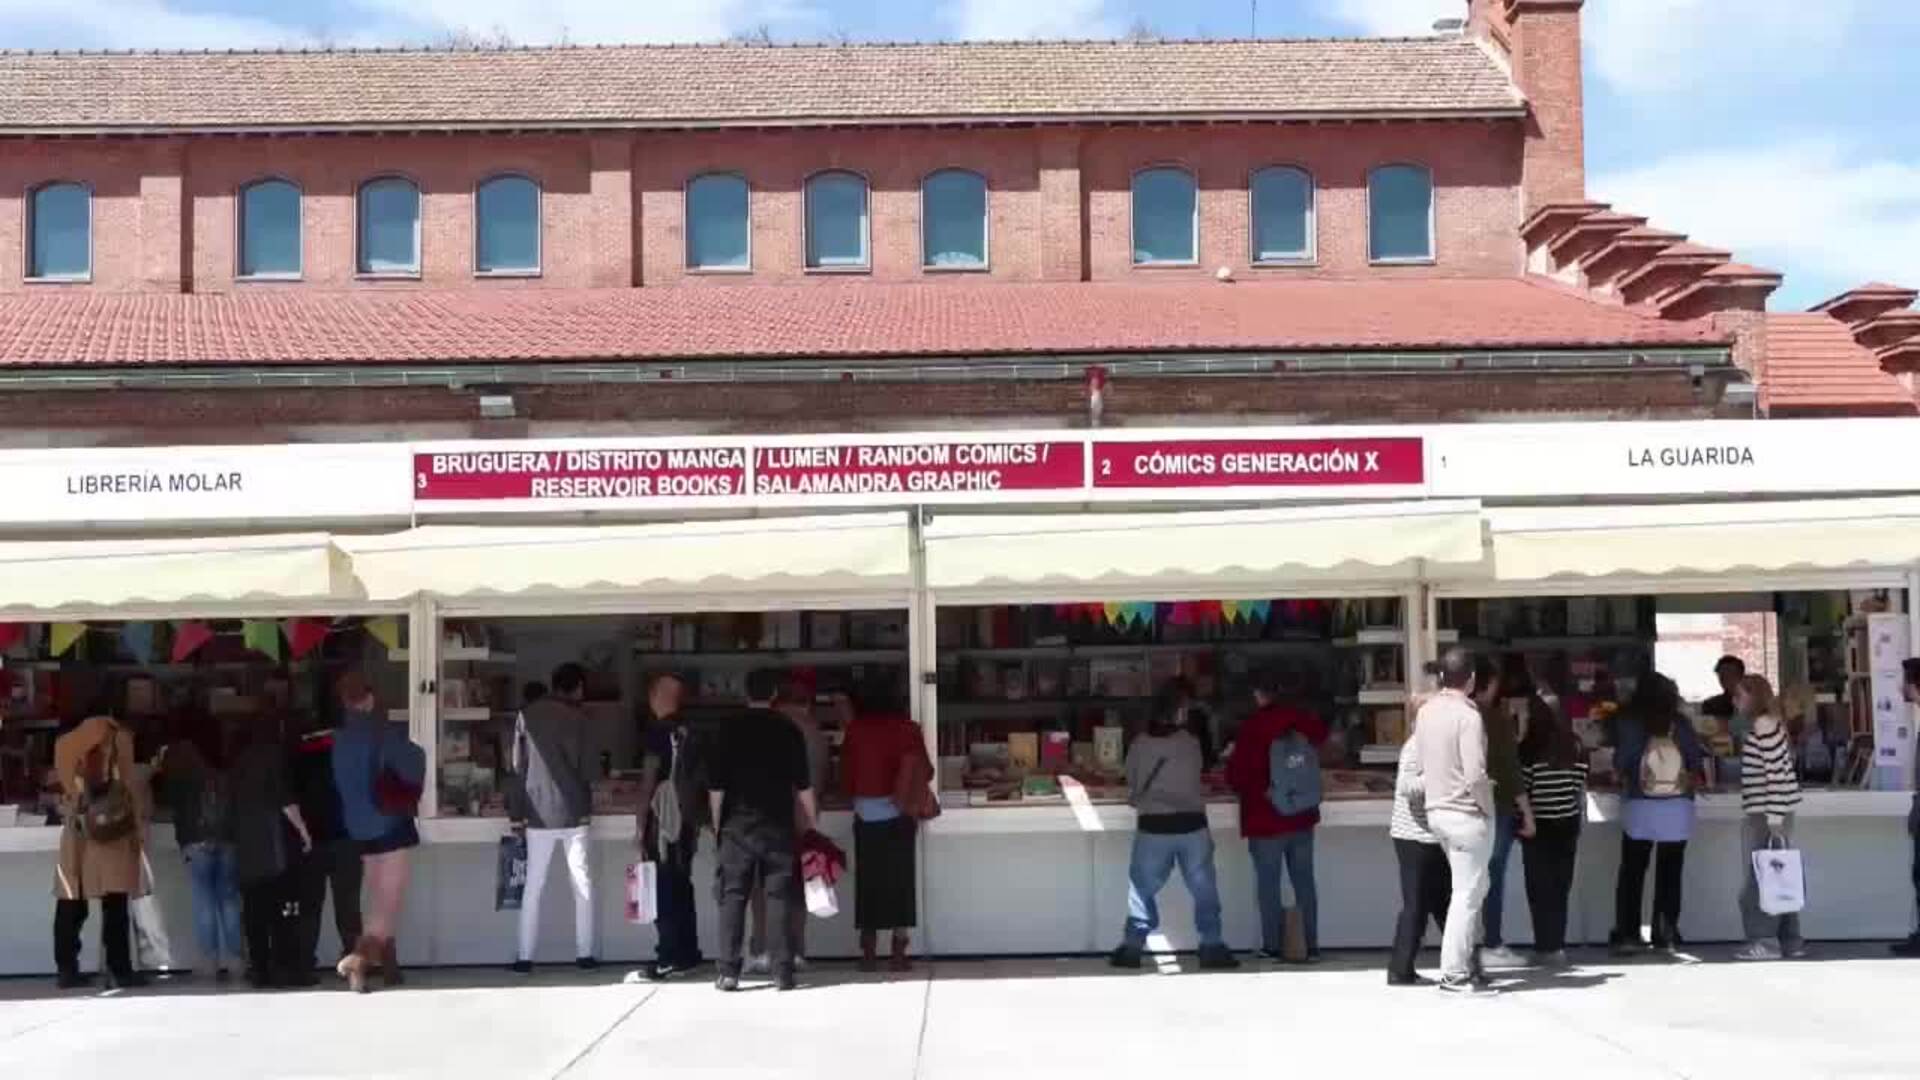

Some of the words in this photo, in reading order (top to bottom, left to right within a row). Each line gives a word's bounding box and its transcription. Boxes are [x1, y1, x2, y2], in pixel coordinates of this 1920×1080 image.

[433, 452, 549, 474] BRUGUERA
[555, 452, 562, 472] /
[567, 450, 661, 472] DISTRITO
[668, 449, 744, 470] MANGA
[755, 447, 762, 468] /
[767, 447, 840, 468] LUMEN
[845, 446, 851, 467] /
[858, 444, 949, 466] RANDOM
[957, 444, 1036, 464] COMICS
[1042, 443, 1049, 463] /
[1102, 460, 1111, 474] 2
[1134, 451, 1215, 474] CÓMICS
[1221, 449, 1358, 473] GENERACIÓN
[1364, 451, 1379, 471] X
[1628, 448, 1654, 467] LA
[1660, 447, 1754, 466] GUARIDA
[67, 470, 162, 494] LIBRERÍA
[169, 472, 242, 492] MOLAR
[417, 473, 427, 488] 3
[531, 475, 651, 497] RESERVOIR
[657, 475, 732, 495] BOOKS
[737, 474, 745, 493] /
[756, 471, 903, 493] SALAMANDRA
[908, 470, 1001, 490] GRAPHIC
